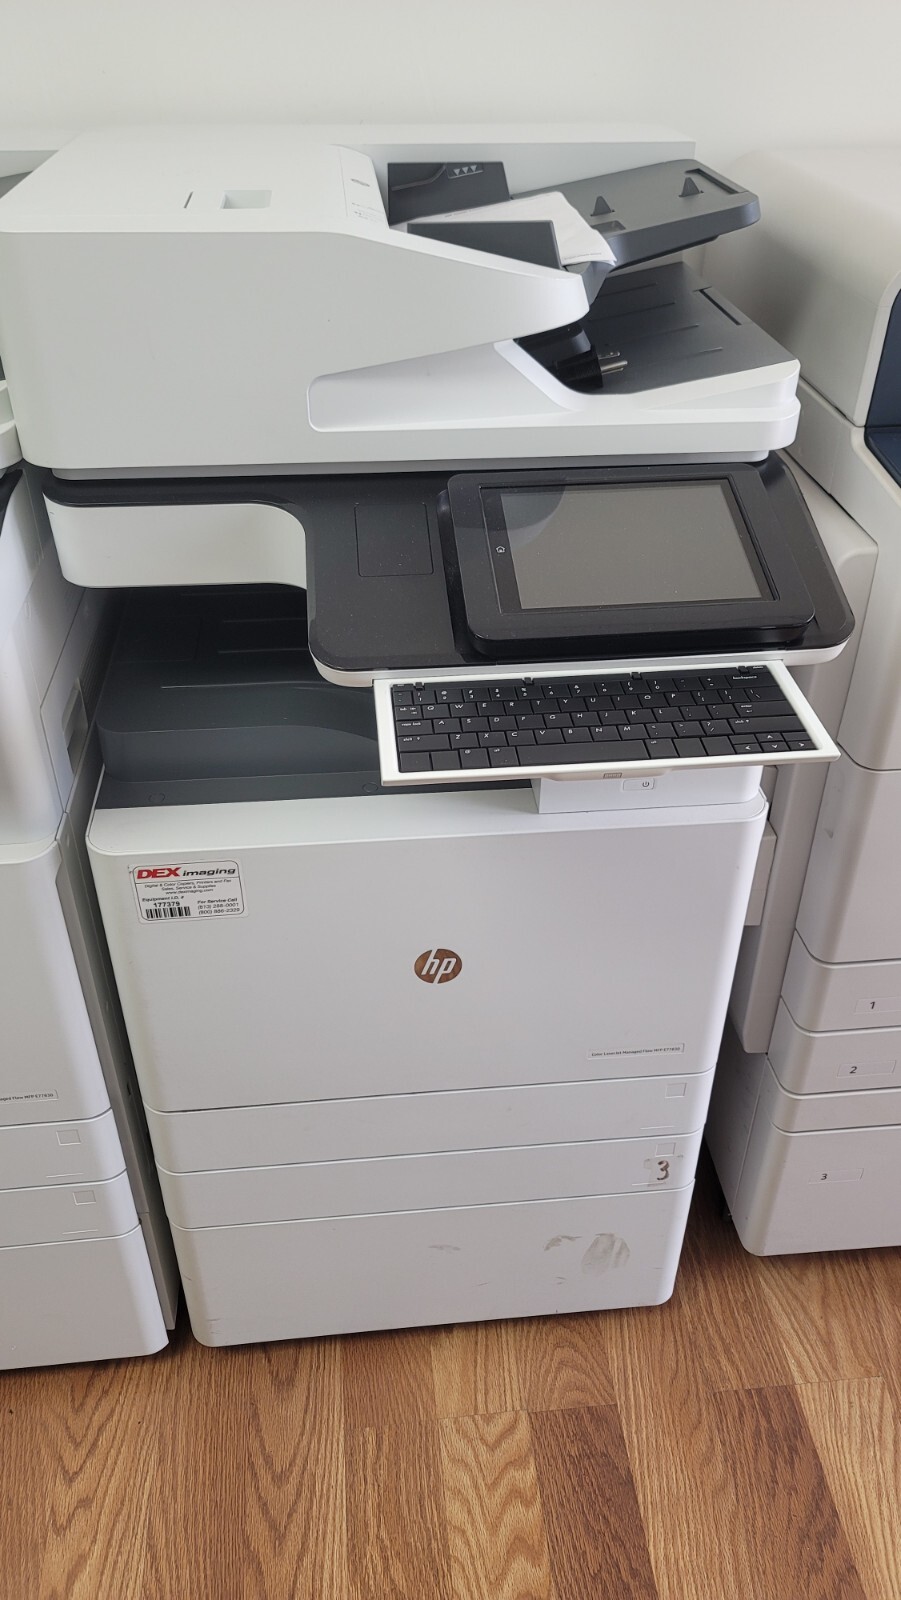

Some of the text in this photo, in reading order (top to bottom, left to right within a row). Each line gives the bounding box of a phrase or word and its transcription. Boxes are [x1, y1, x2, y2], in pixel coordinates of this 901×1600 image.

[137, 867, 236, 879] DEX imaging
[420, 949, 457, 984] hp
[870, 1001, 875, 1009] 1
[849, 1066, 857, 1074] 2
[656, 1160, 670, 1181] 3
